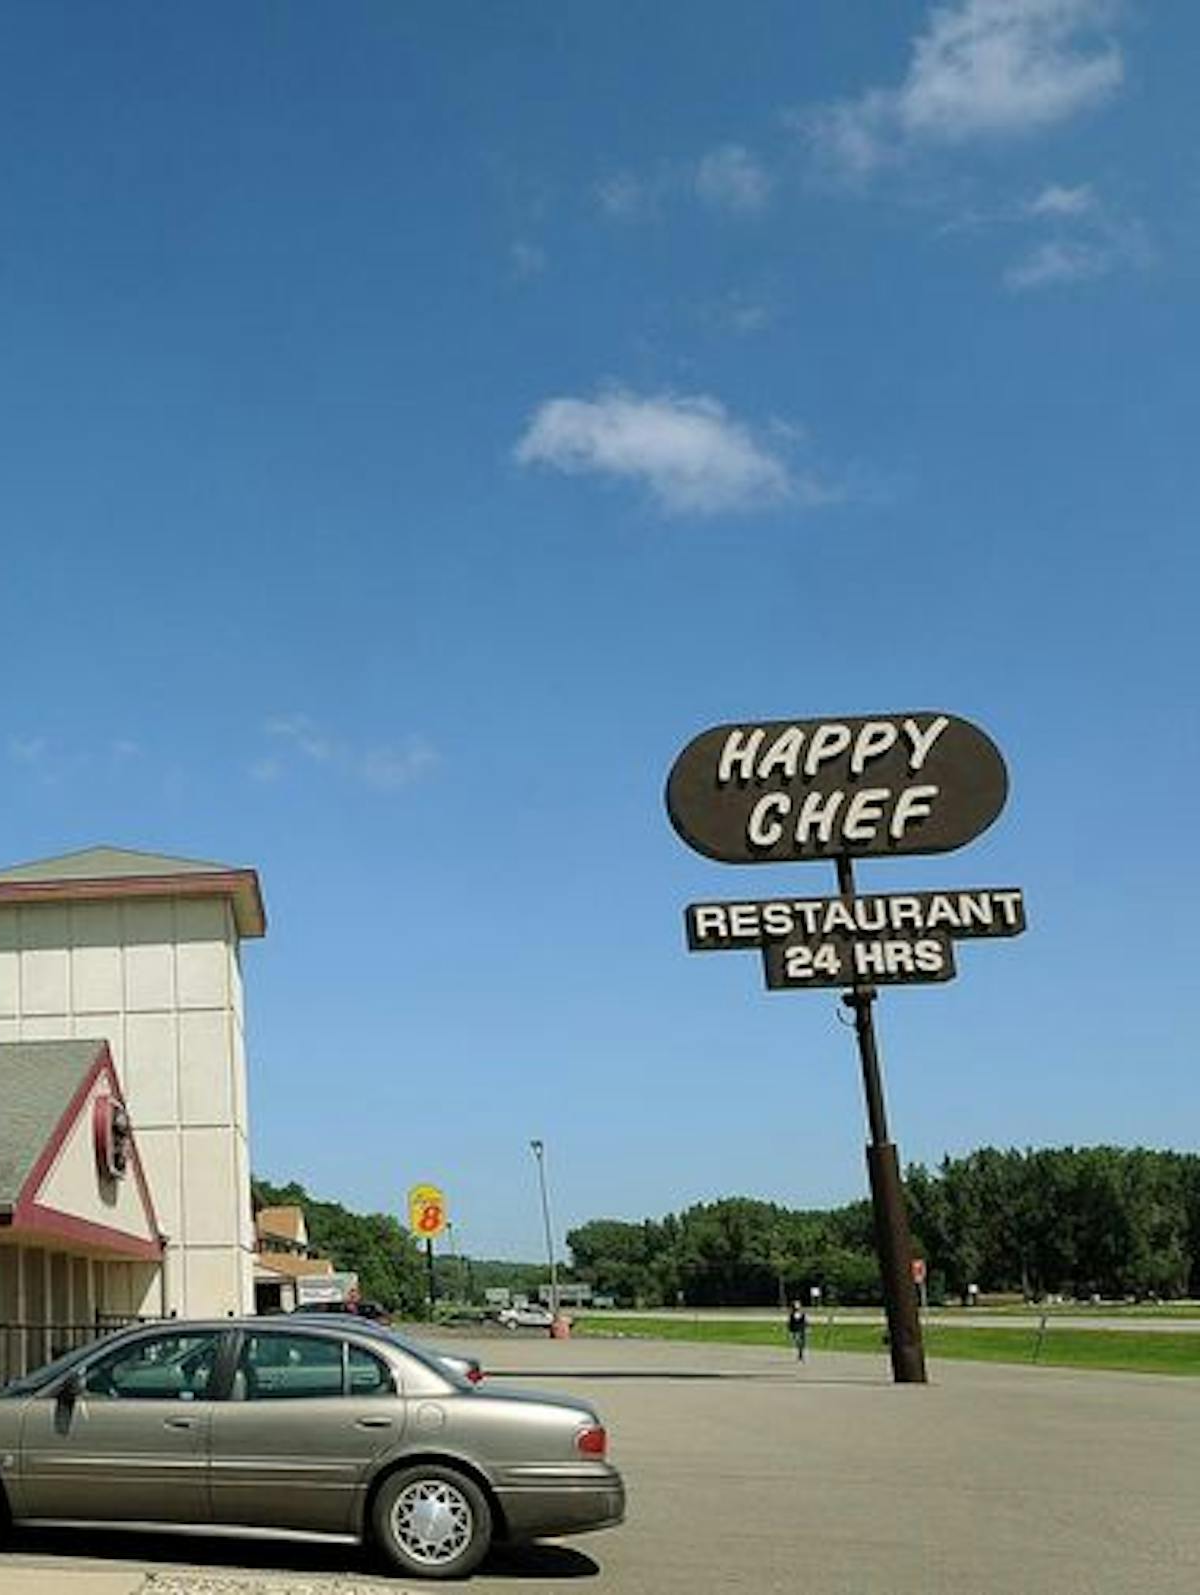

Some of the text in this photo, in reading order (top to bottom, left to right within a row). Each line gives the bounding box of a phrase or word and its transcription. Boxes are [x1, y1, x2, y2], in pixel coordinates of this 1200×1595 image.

[718, 716, 949, 780] HAPPY
[748, 784, 939, 846] CHEF
[694, 892, 1022, 938] RESTAURANT
[784, 939, 943, 979] 24 HRS
[419, 1206, 441, 1231] 8
